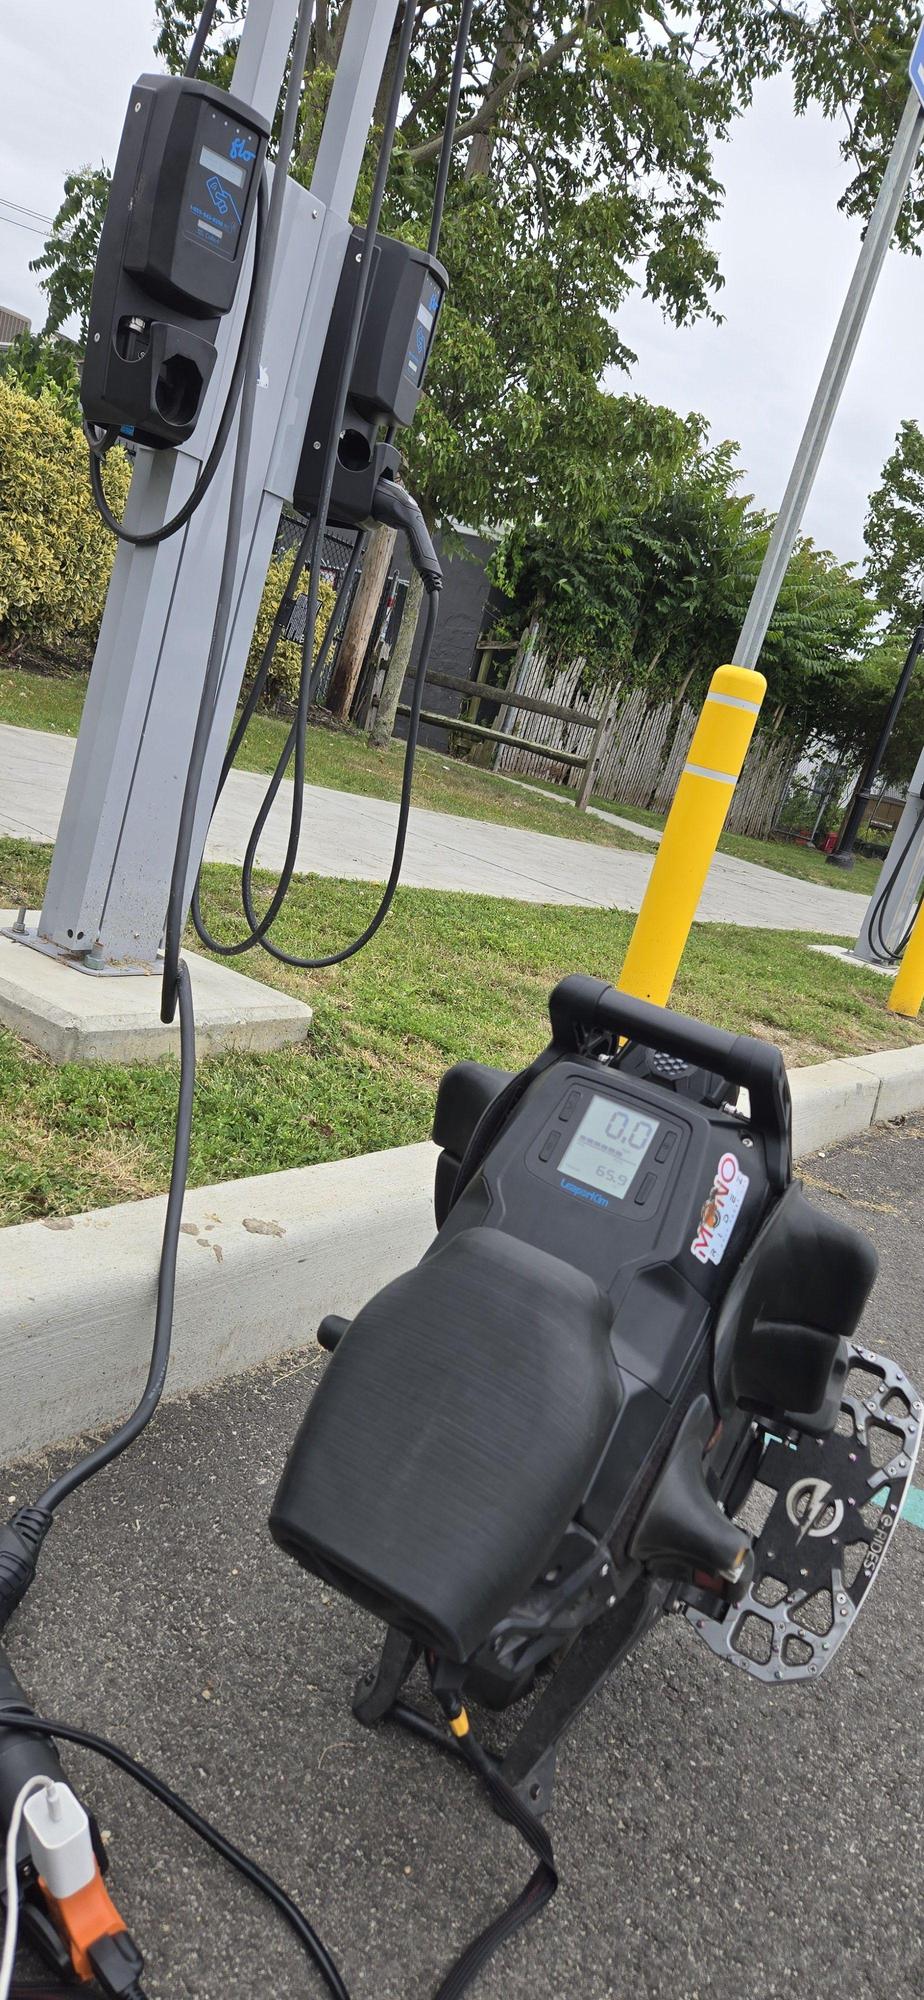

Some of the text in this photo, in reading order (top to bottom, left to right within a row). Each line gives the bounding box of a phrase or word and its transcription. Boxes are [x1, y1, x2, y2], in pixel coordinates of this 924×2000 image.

[229, 138, 256, 161] flo
[605, 1111, 653, 1150] 0.0
[595, 1164, 628, 1187] 65.9
